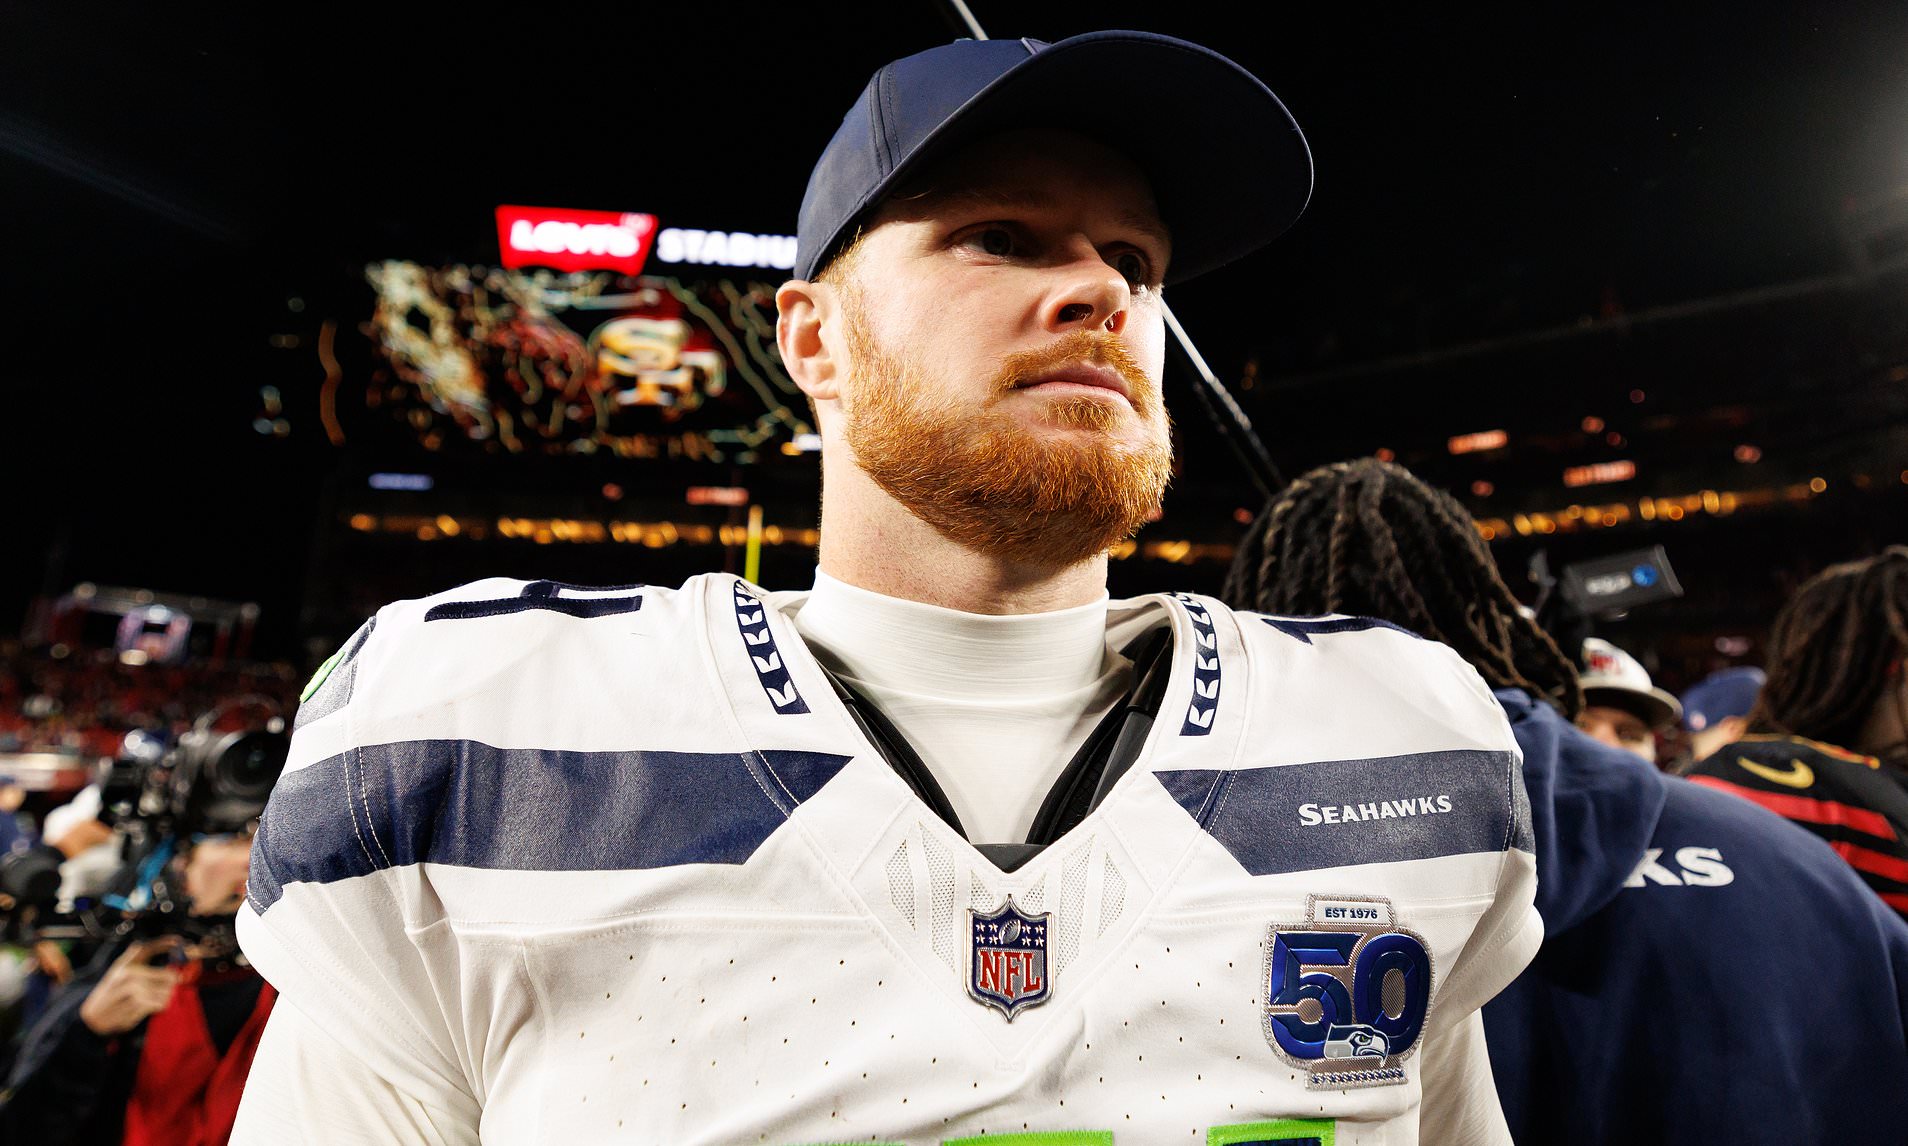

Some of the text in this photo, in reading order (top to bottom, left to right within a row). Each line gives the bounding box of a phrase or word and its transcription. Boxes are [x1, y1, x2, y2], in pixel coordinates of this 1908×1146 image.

[657, 228, 798, 269] STADIU
[1298, 795, 1452, 826] SEAHAWKS
[1325, 907, 1378, 919] EST 1976
[978, 950, 1042, 999] NFL
[1270, 931, 1431, 1060] 50
